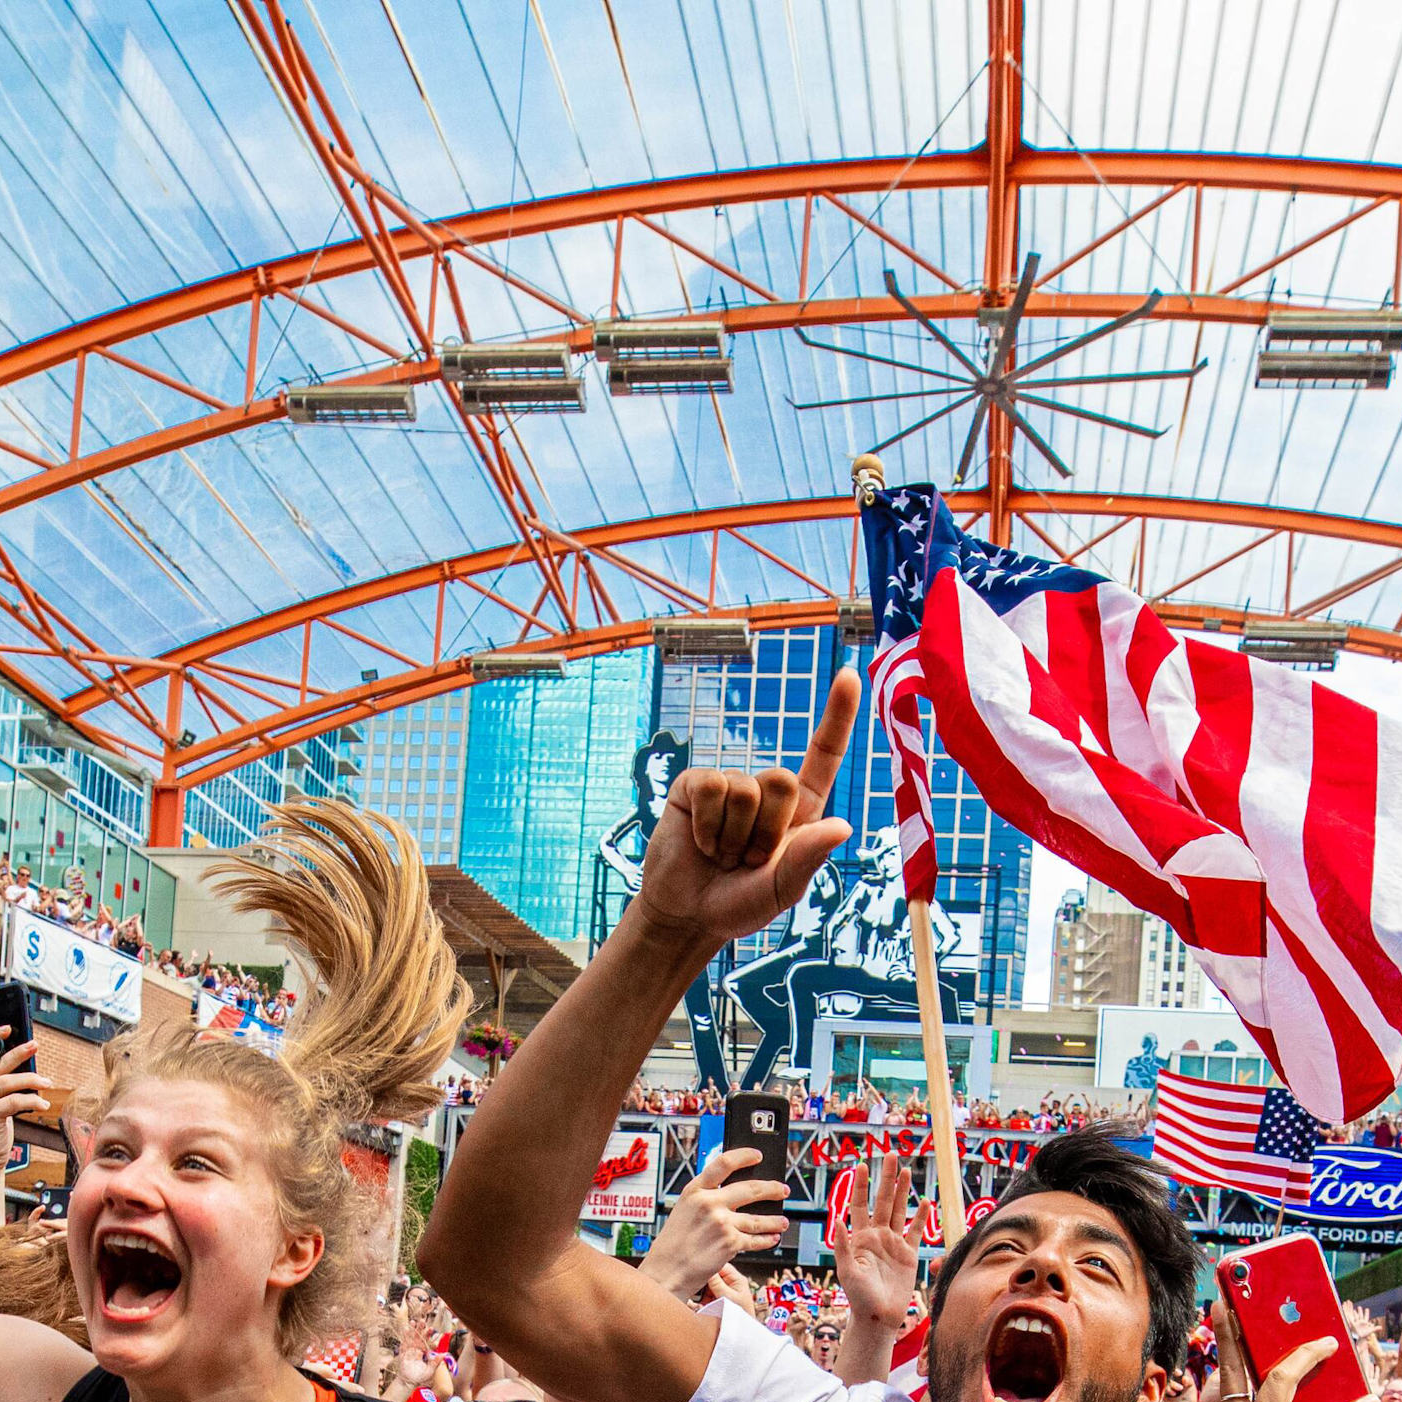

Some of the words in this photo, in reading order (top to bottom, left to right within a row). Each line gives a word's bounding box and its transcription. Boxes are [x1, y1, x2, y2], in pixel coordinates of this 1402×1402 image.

[812, 1129, 968, 1166] KANSAS
[623, 1195, 654, 1208] LODGE
[1318, 1227, 1368, 1243] FORD
